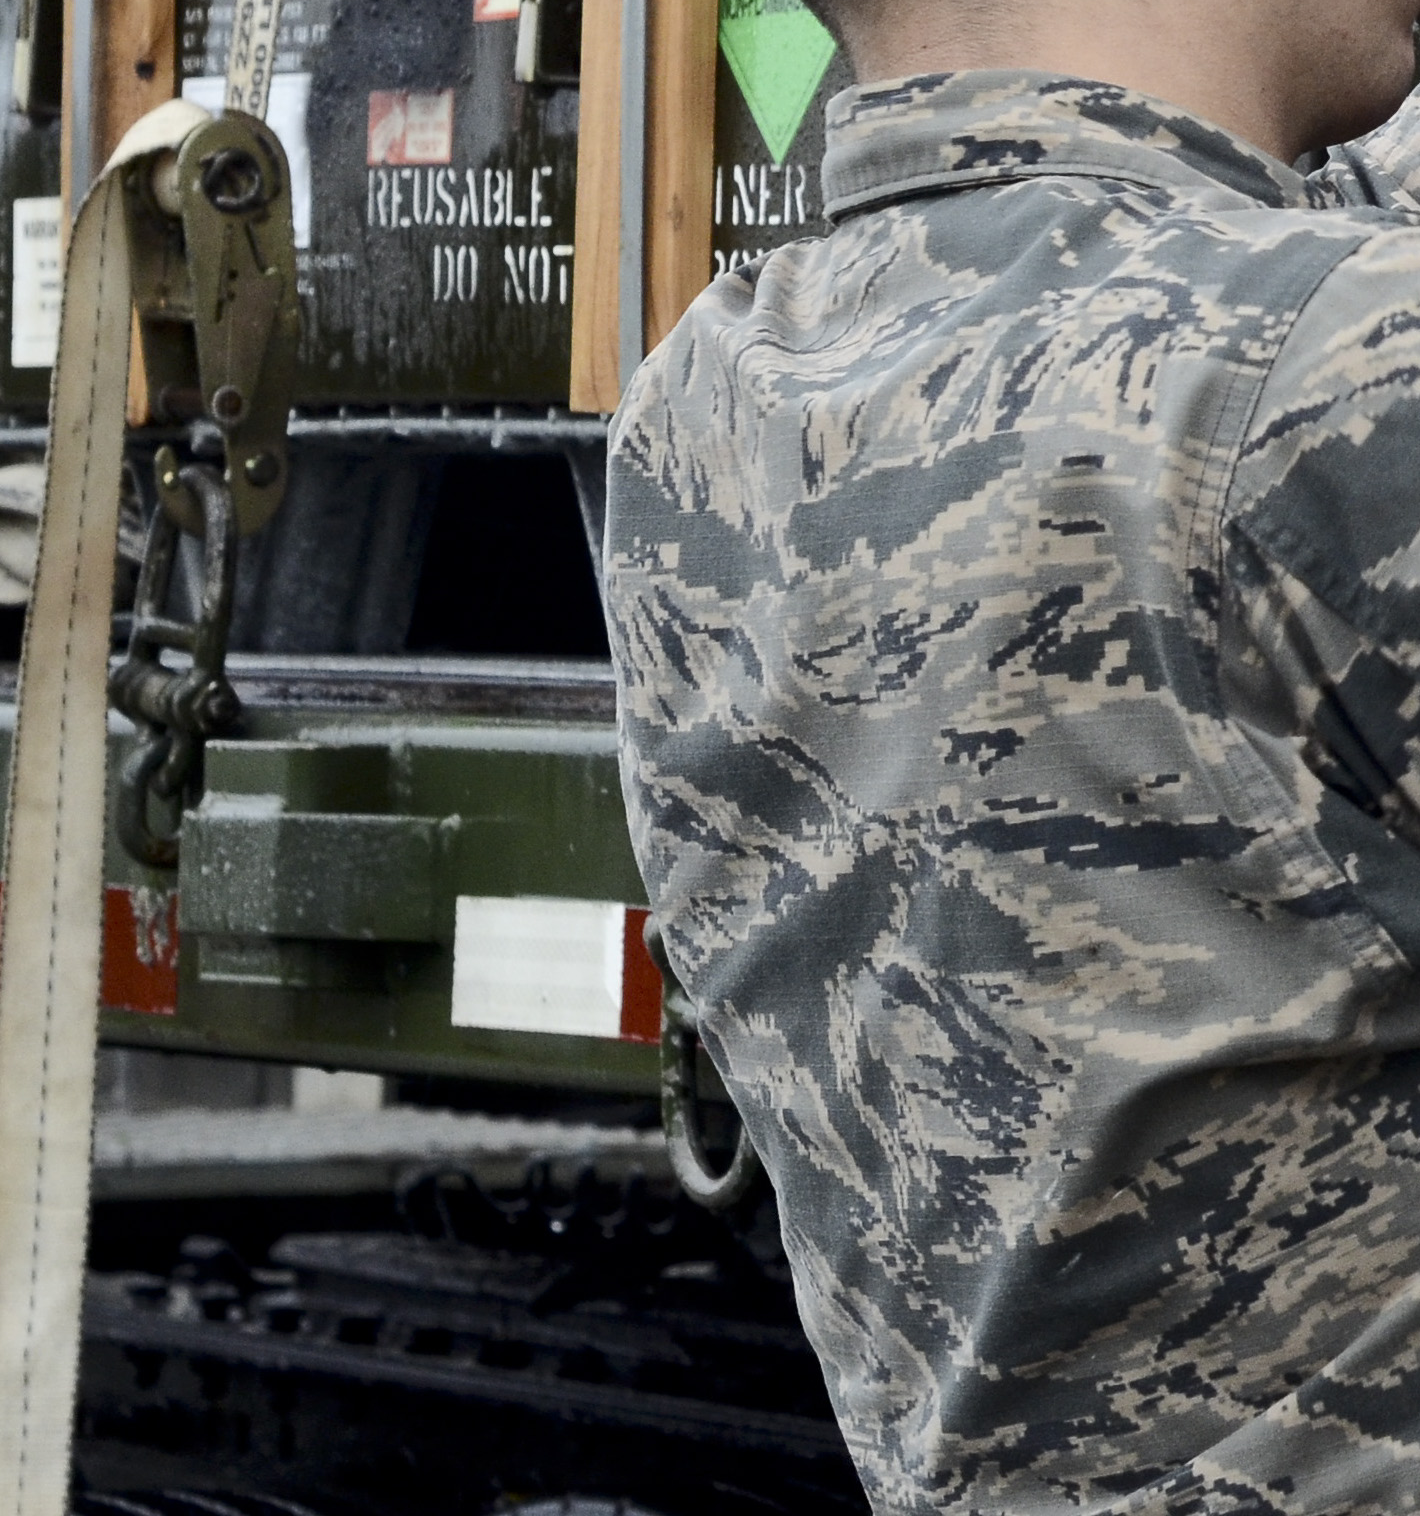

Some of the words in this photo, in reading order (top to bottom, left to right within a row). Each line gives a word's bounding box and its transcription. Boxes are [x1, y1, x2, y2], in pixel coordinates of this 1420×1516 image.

[368, 166, 552, 227] REUSABLE
[715, 164, 805, 225] INER
[433, 244, 478, 302] DO
[504, 244, 574, 304] NOT
